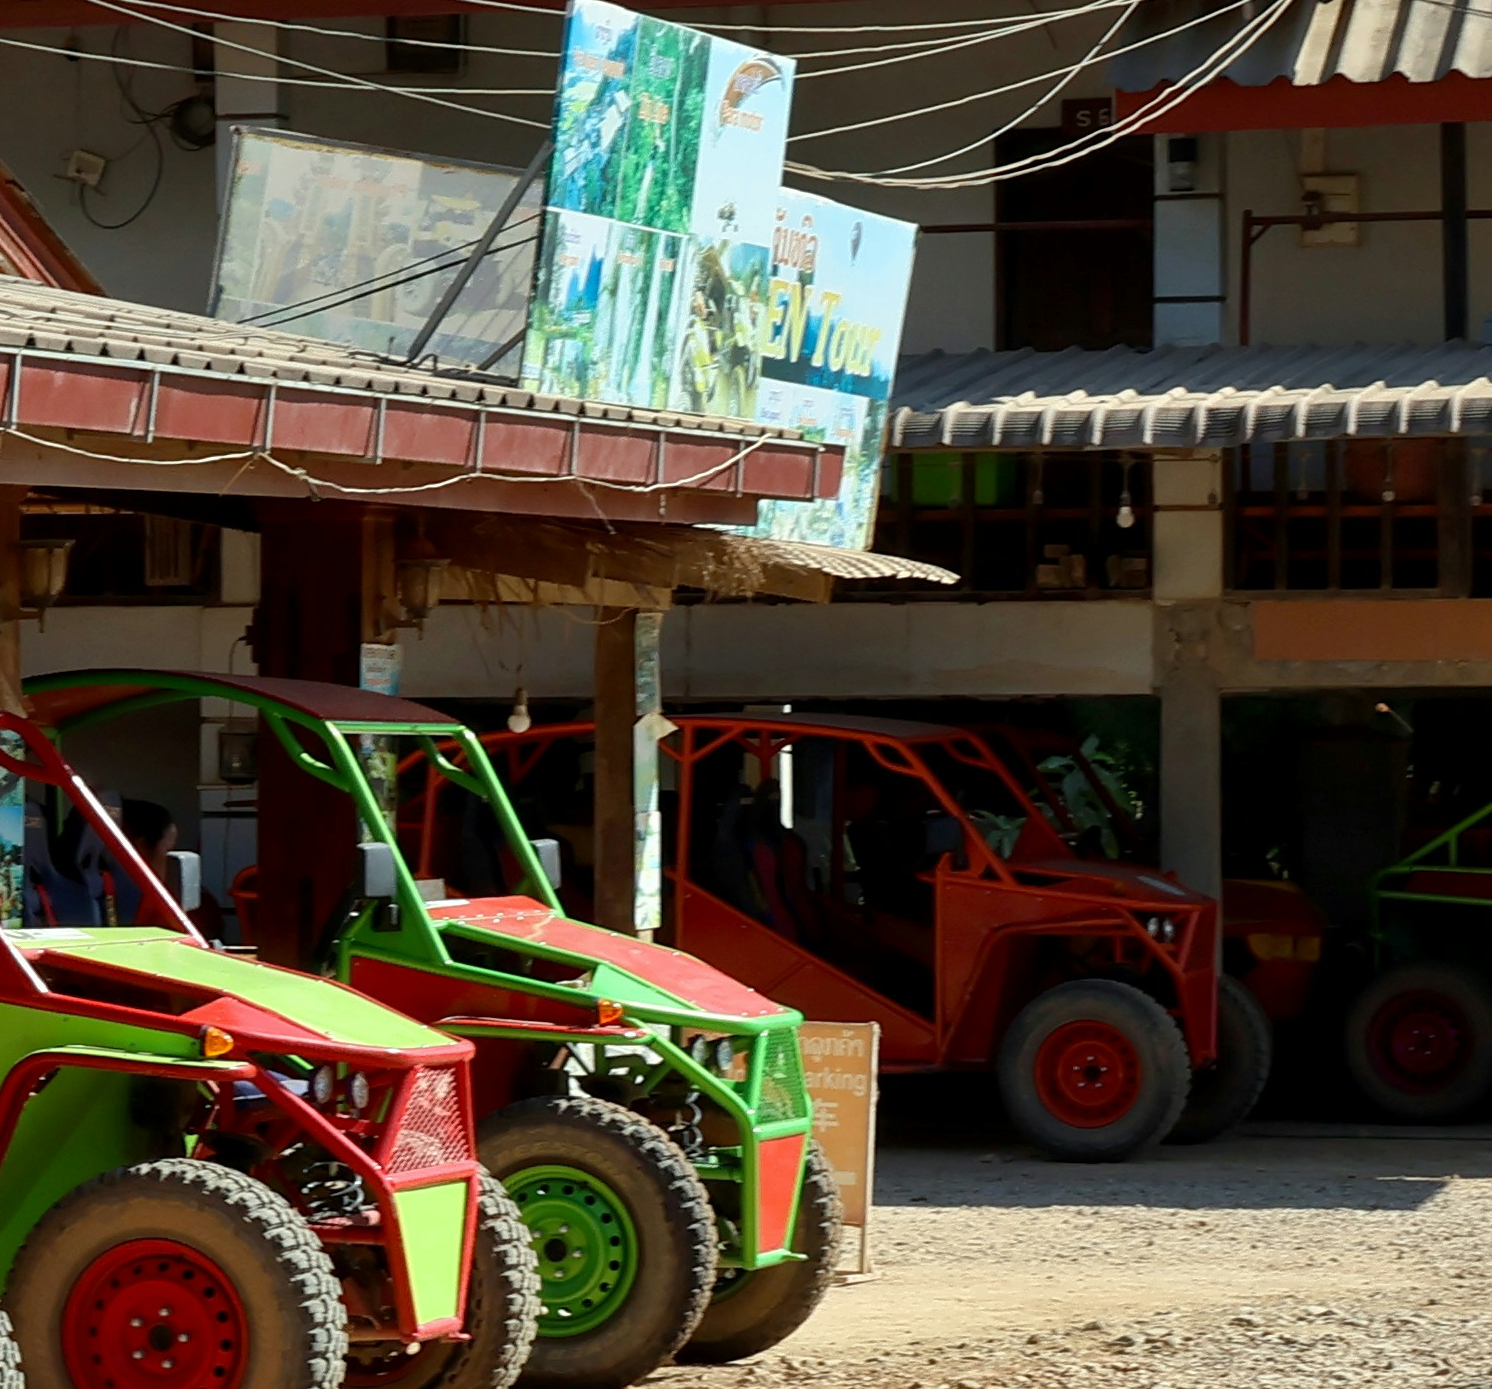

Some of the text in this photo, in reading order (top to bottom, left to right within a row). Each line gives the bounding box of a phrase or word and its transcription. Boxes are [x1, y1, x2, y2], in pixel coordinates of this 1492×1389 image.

[759, 277, 884, 378] EN Tour
[805, 1066, 869, 1097] arking
